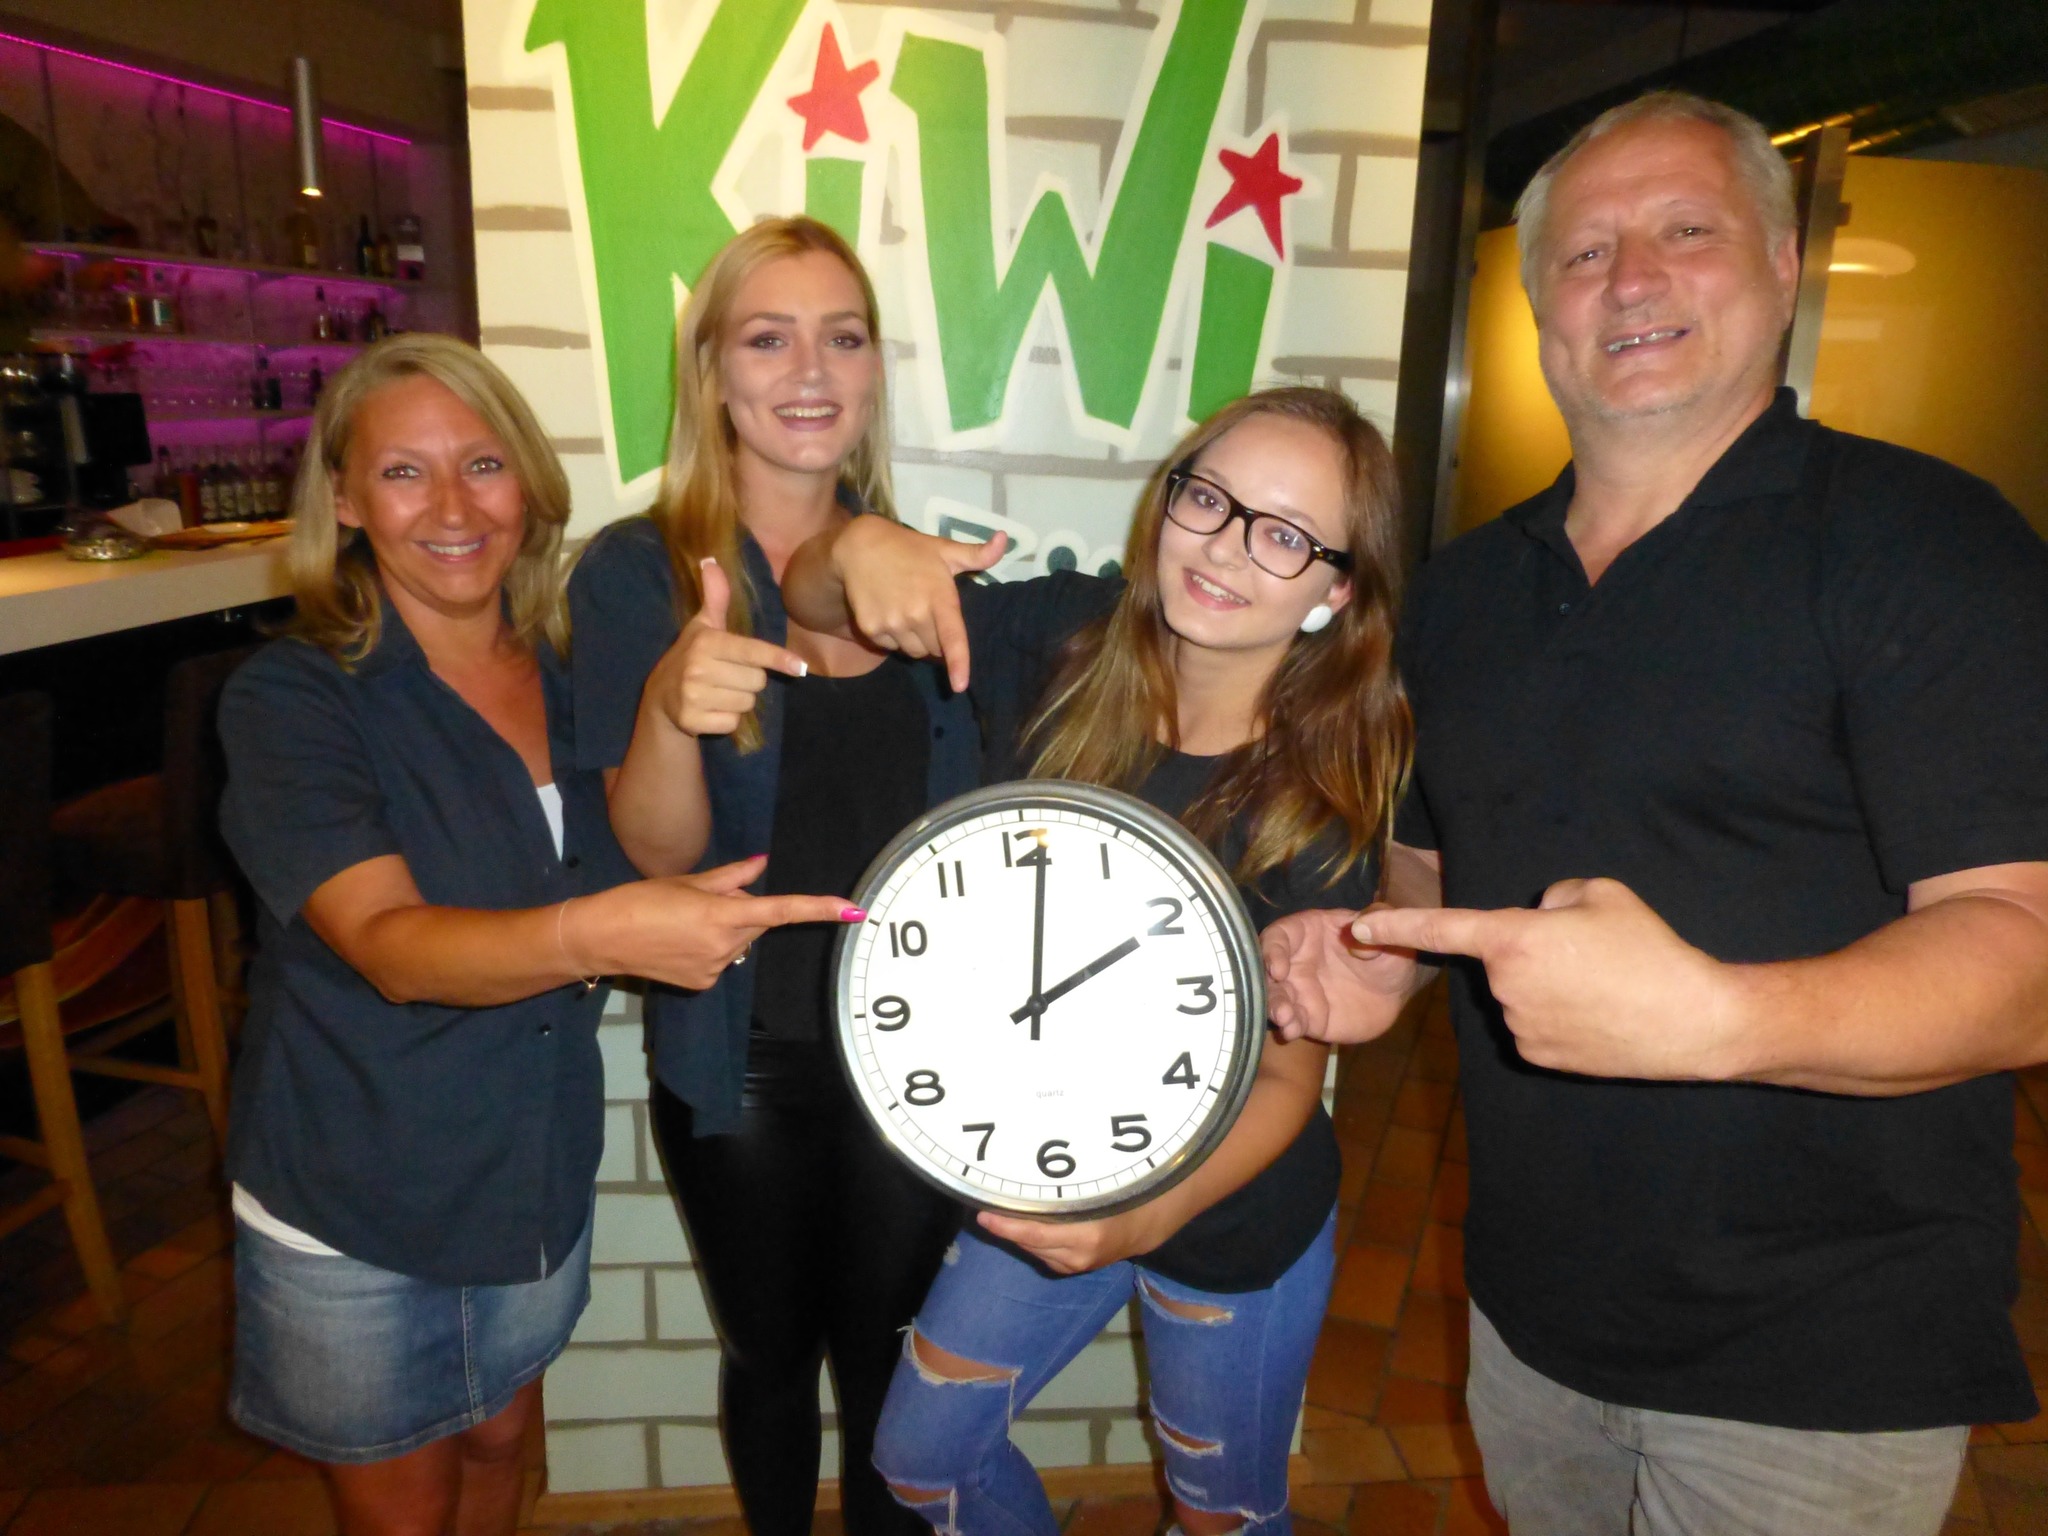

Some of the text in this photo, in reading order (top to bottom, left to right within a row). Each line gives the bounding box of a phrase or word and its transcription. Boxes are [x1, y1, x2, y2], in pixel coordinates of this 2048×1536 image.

[1001, 828, 1053, 868] 12
[1099, 842, 1111, 880] 1
[936, 860, 965, 898] 11
[1145, 896, 1185, 936] 2
[888, 919, 928, 958] 10
[871, 994, 911, 1032] 9
[1175, 974, 1218, 1016] 3
[903, 1069, 946, 1107] 8
[1161, 1050, 1201, 1090] 4
[961, 1121, 996, 1162] 7
[1110, 1113, 1153, 1153] 5
[1035, 1138, 1077, 1180] 6
